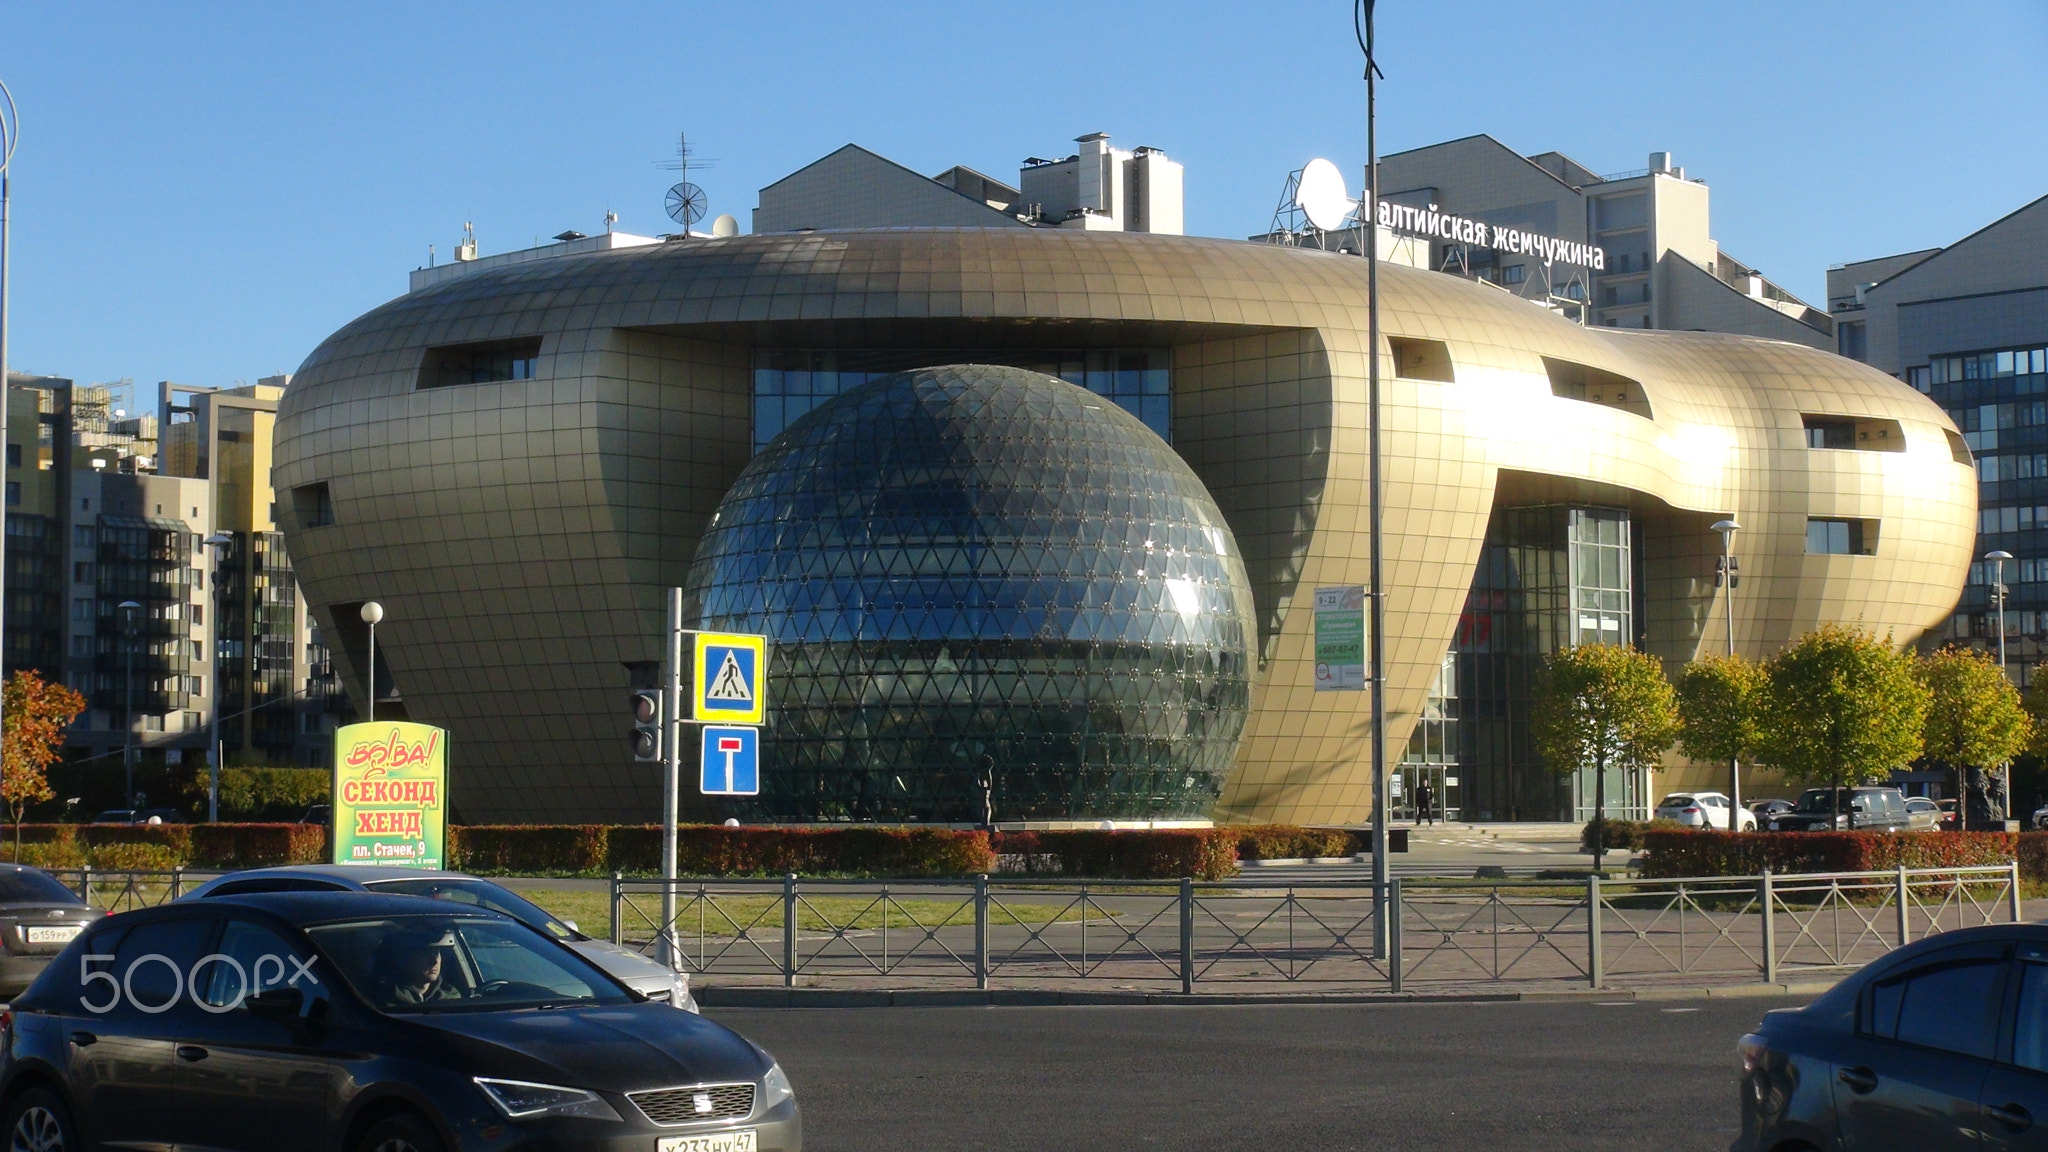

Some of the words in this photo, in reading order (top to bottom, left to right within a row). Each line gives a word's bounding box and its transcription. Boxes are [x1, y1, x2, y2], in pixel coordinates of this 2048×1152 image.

[1492, 225, 1605, 270] жемчужина
[344, 781, 436, 806] СЕКОНД
[357, 812, 421, 837] ХЕНД
[352, 846, 371, 858] пл.
[374, 842, 416, 858] Стачек,
[418, 841, 426, 856] 9
[736, 1134, 751, 1150] 47
